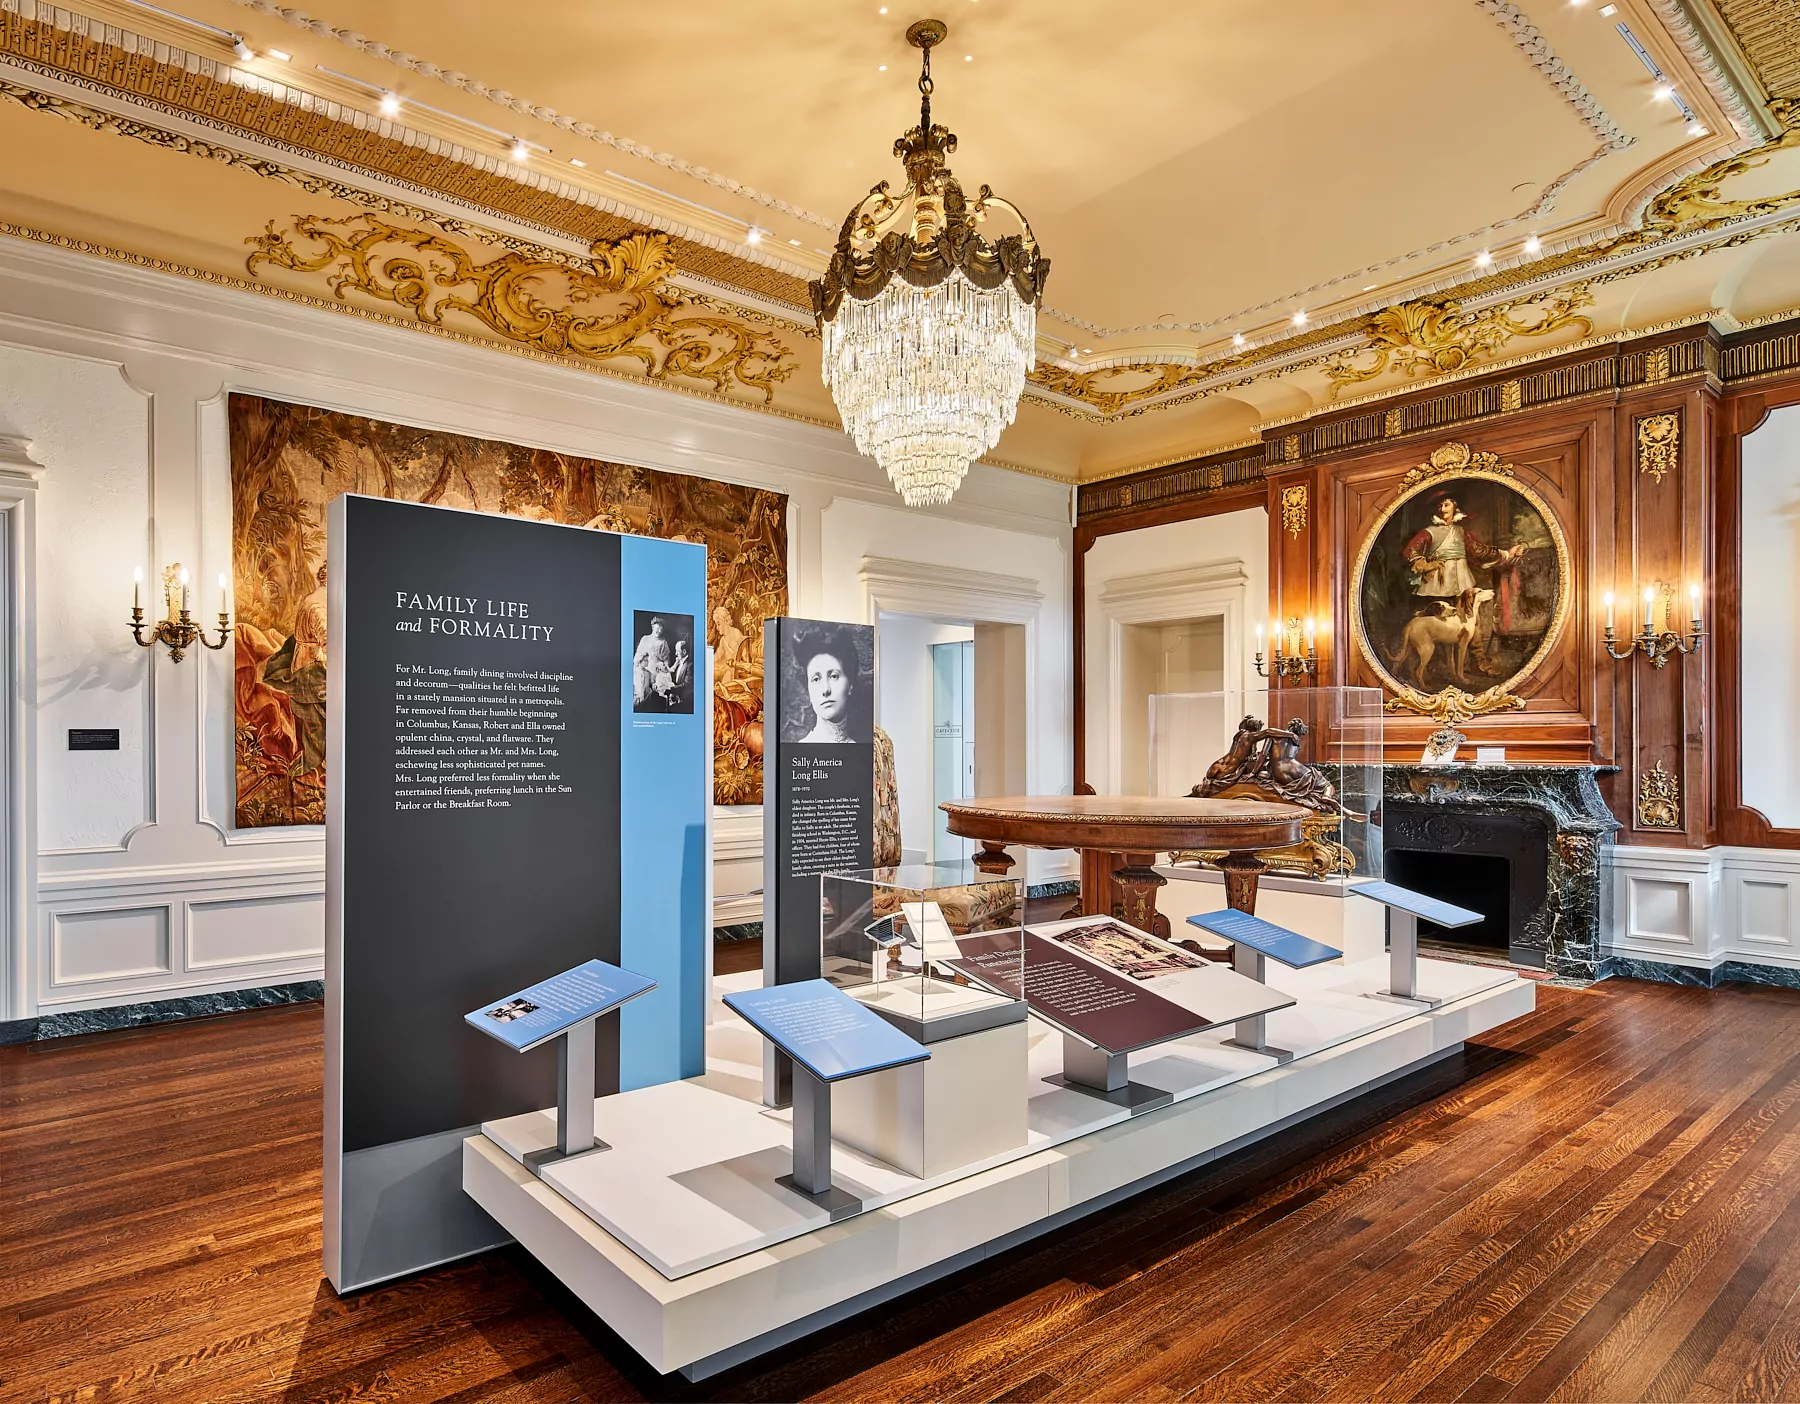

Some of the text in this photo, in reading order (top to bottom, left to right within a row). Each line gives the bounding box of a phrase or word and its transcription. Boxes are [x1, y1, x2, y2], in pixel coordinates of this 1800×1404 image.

[396, 591, 529, 619] FAMILY LIFE
[395, 617, 554, 642] and FORMALITY
[395, 664, 574, 683] For Mr. Long, family dining involved discipline
[395, 678, 412, 687] and
[492, 681, 503, 691] he
[504, 682, 517, 692] felt
[518, 682, 546, 693] befitted
[548, 684, 560, 693] life
[395, 692, 405, 701] in
[413, 692, 441, 704] stately
[442, 694, 476, 703] mansion
[477, 695, 508, 704] situated
[509, 696, 518, 704] in
[525, 696, 565, 707] metropolis.
[395, 705, 558, 720] Far removed from their humble beginnings
[395, 719, 566, 731] in Columbus, Kansas, Robert and Ella owned
[395, 732, 554, 745] opulent china, crystal, and flatware. They
[395, 746, 435, 756] addressed
[436, 746, 456, 756] each
[457, 746, 479, 756] other
[489, 746, 504, 756] Mr.
[504, 746, 519, 756] and
[520, 746, 537, 756] Mrs.
[538, 747, 559, 757] Long,
[395, 759, 438, 771] eschewing
[439, 759, 454, 769] less
[455, 759, 506, 771] sophisticated
[507, 761, 520, 770] pet
[792, 757, 842, 768] Sally America
[395, 771, 561, 784] Mrs. Long preferred less formality when she
[792, 770, 828, 782] Long Ellis
[395, 784, 572, 797] entertained friends, preferring lunch in the Sun
[395, 800, 421, 811] Parlor
[433, 800, 447, 809] the
[449, 799, 485, 809] Breakfast
[486, 798, 512, 808] Room.
[966, 954, 998, 962] Family
